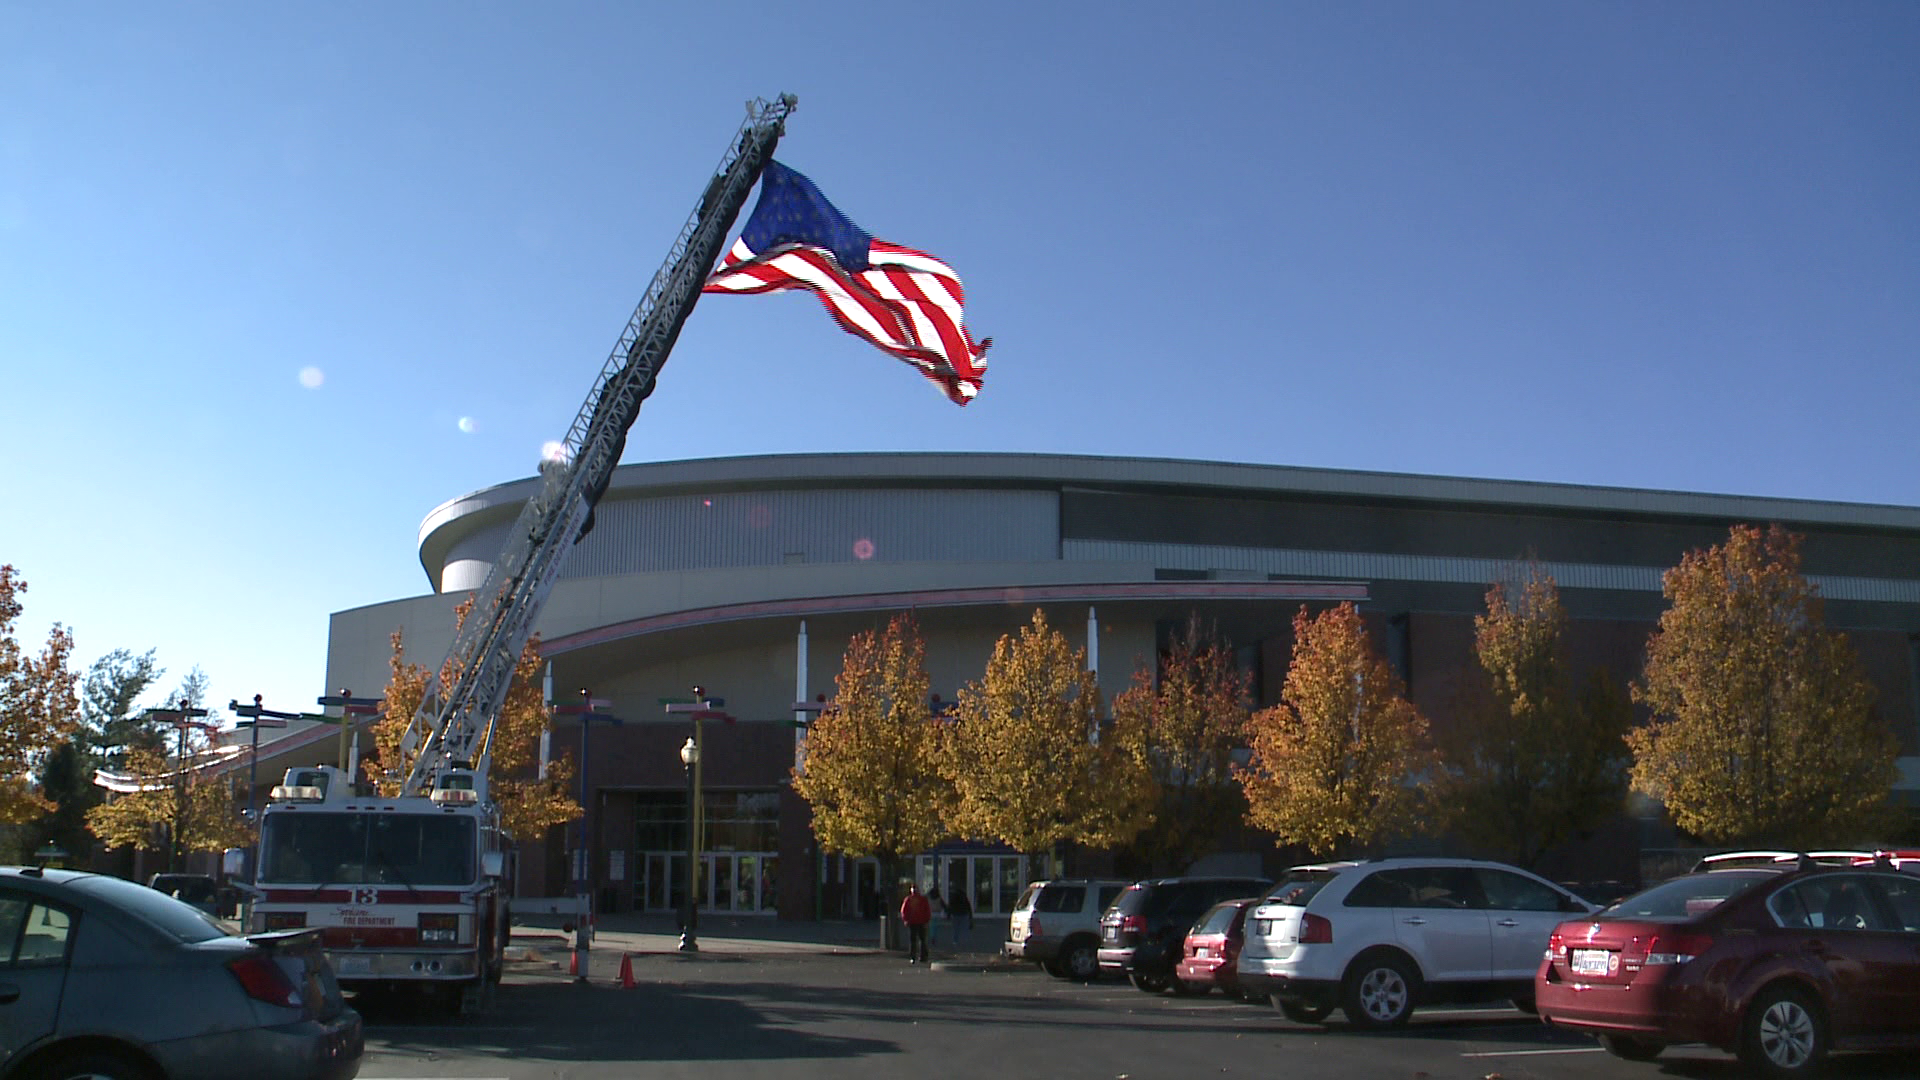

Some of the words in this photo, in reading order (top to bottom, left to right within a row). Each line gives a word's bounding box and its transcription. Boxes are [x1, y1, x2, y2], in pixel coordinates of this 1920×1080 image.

[349, 885, 379, 905] 13
[343, 916, 356, 925] FIRE
[357, 916, 395, 925] DEPARTMENT
